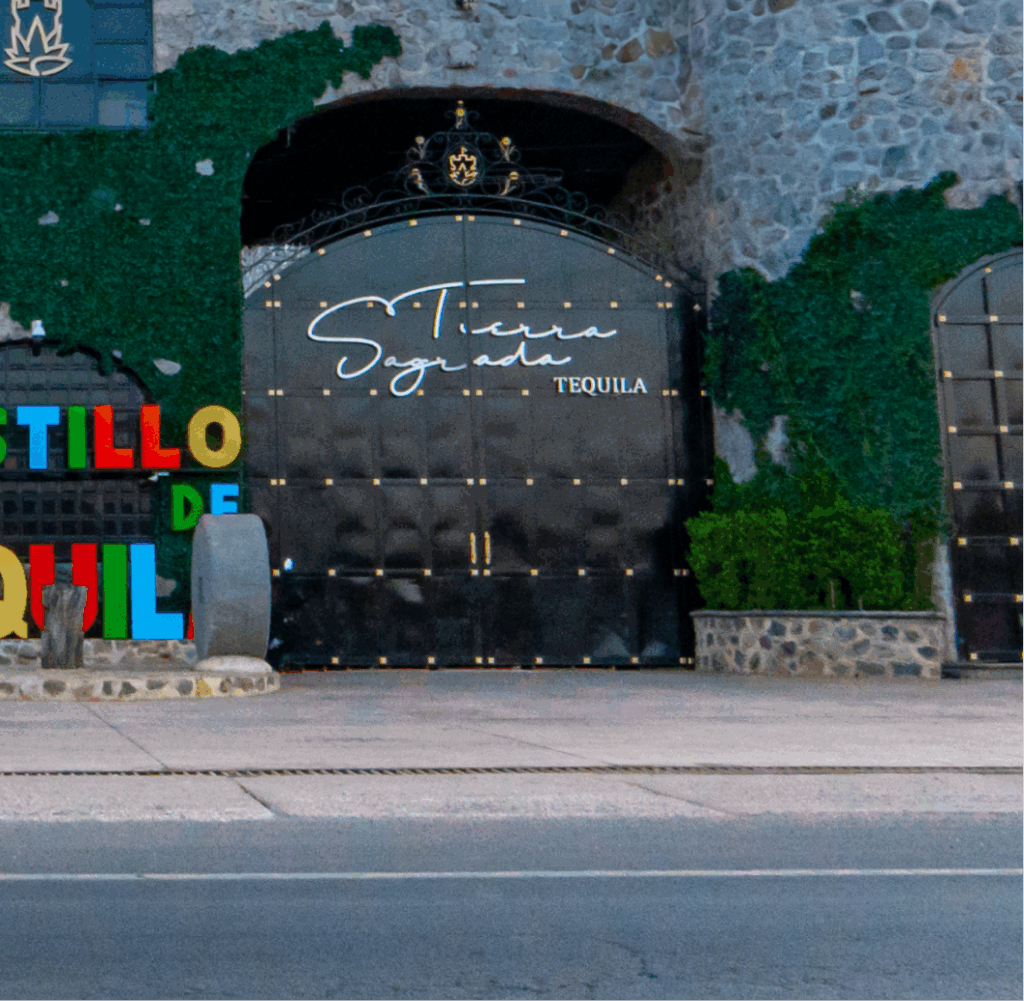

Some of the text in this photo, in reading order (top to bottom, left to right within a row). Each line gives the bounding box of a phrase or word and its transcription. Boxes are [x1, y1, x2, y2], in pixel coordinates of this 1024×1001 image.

[307, 296, 573, 397] Sagrada
[554, 376, 648, 395] TEQUILA
[171, 483, 240, 531] DE
